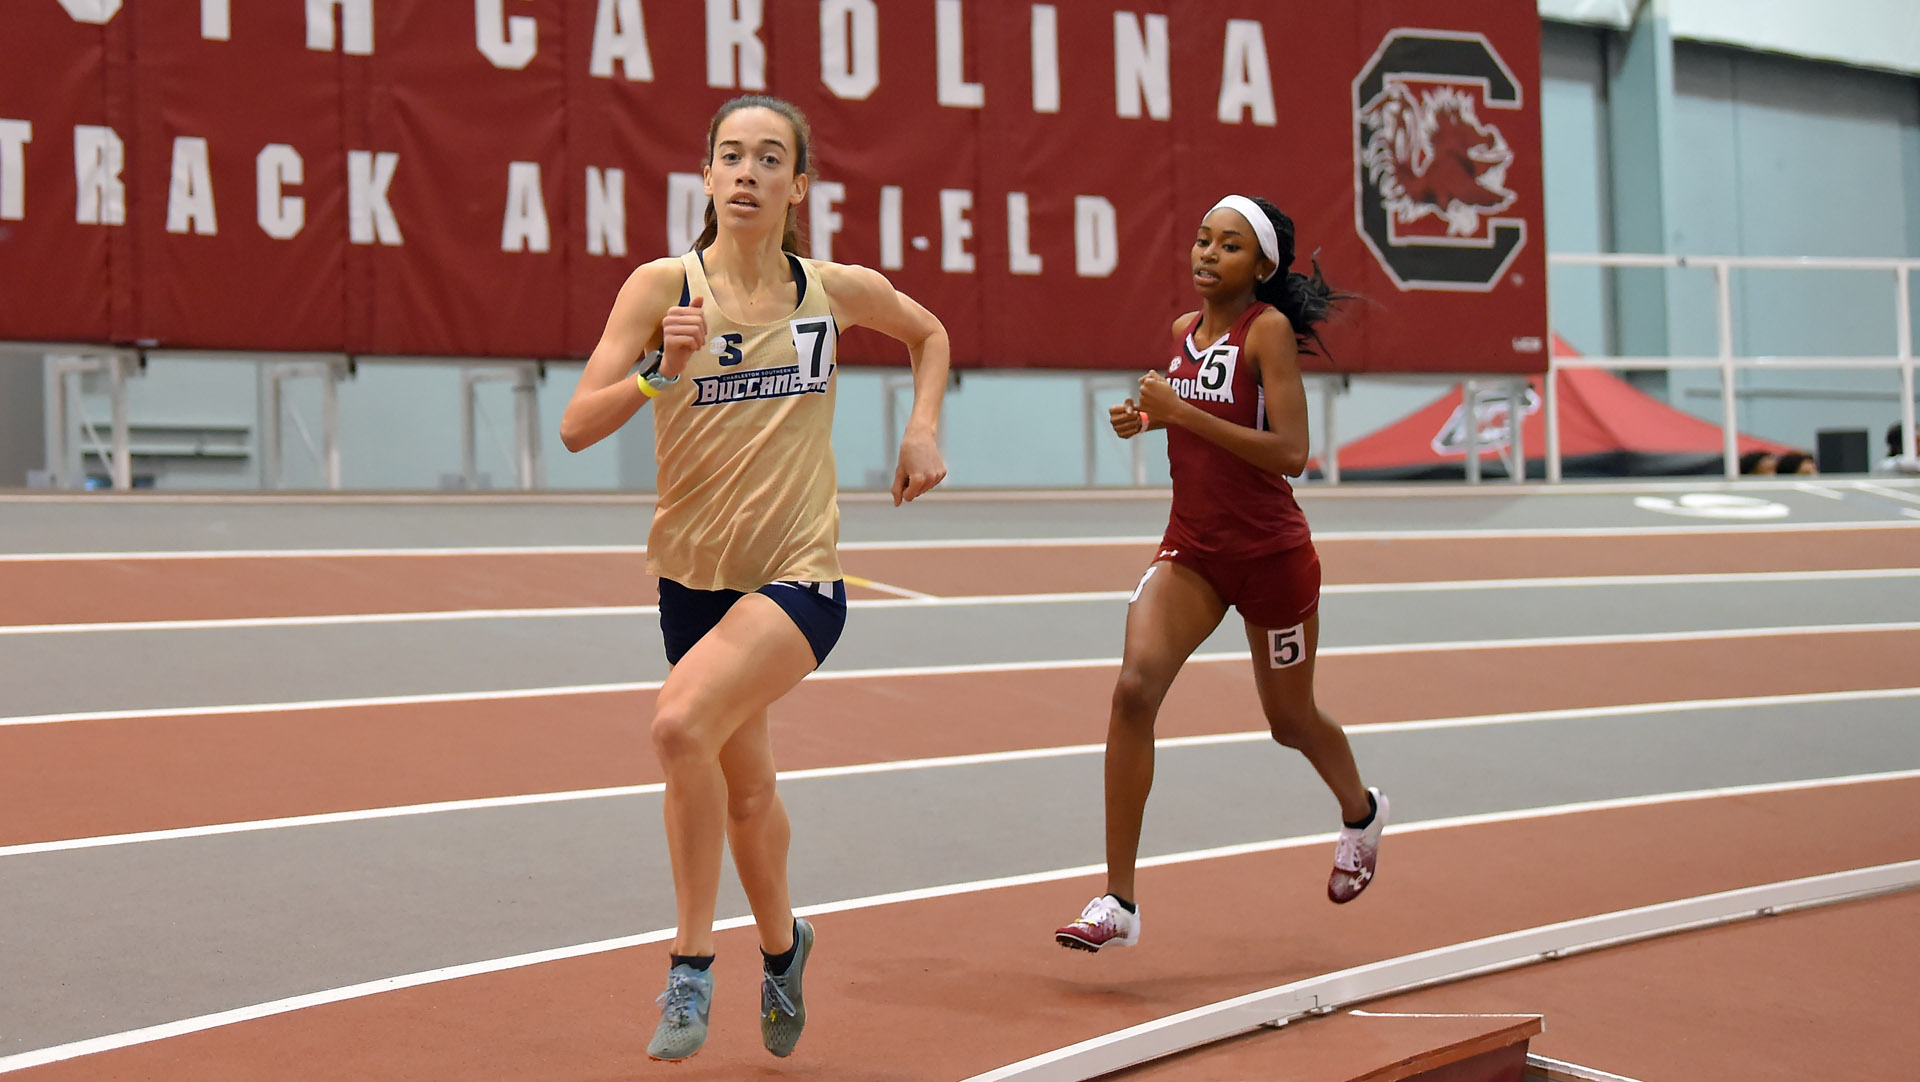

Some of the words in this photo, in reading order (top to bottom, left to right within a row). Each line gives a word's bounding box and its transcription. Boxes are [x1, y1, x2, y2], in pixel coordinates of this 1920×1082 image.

[475, 0, 1278, 127] CAROLINA
[0, 118, 404, 246] TRACK
[501, 161, 706, 257] AND
[809, 181, 1118, 277] FIELD
[722, 371, 760, 381] CHARLESTON
[761, 367, 792, 377] SOUTHERN
[795, 321, 828, 378] 7
[1201, 349, 1230, 390] 5
[1273, 629, 1300, 666] 5
